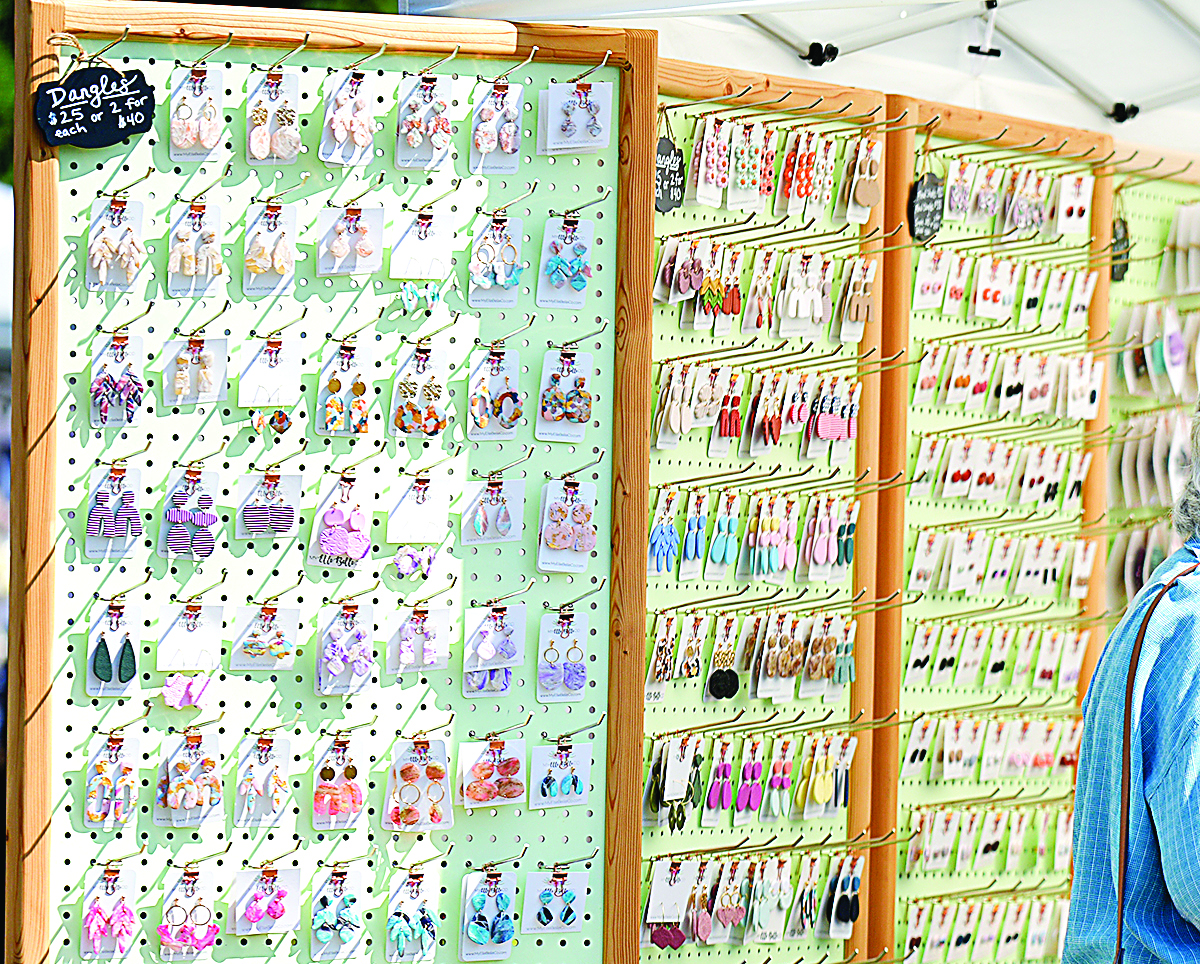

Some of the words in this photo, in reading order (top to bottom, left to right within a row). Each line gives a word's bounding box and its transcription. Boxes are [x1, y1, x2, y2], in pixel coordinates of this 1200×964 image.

[46, 74, 138, 108] Dangles
[48, 107, 85, 126] $25
[90, 111, 104, 123] or
[109, 101, 122, 114] 2
[124, 95, 149, 110] for
[54, 123, 88, 139] each
[117, 111, 145, 129] $40
